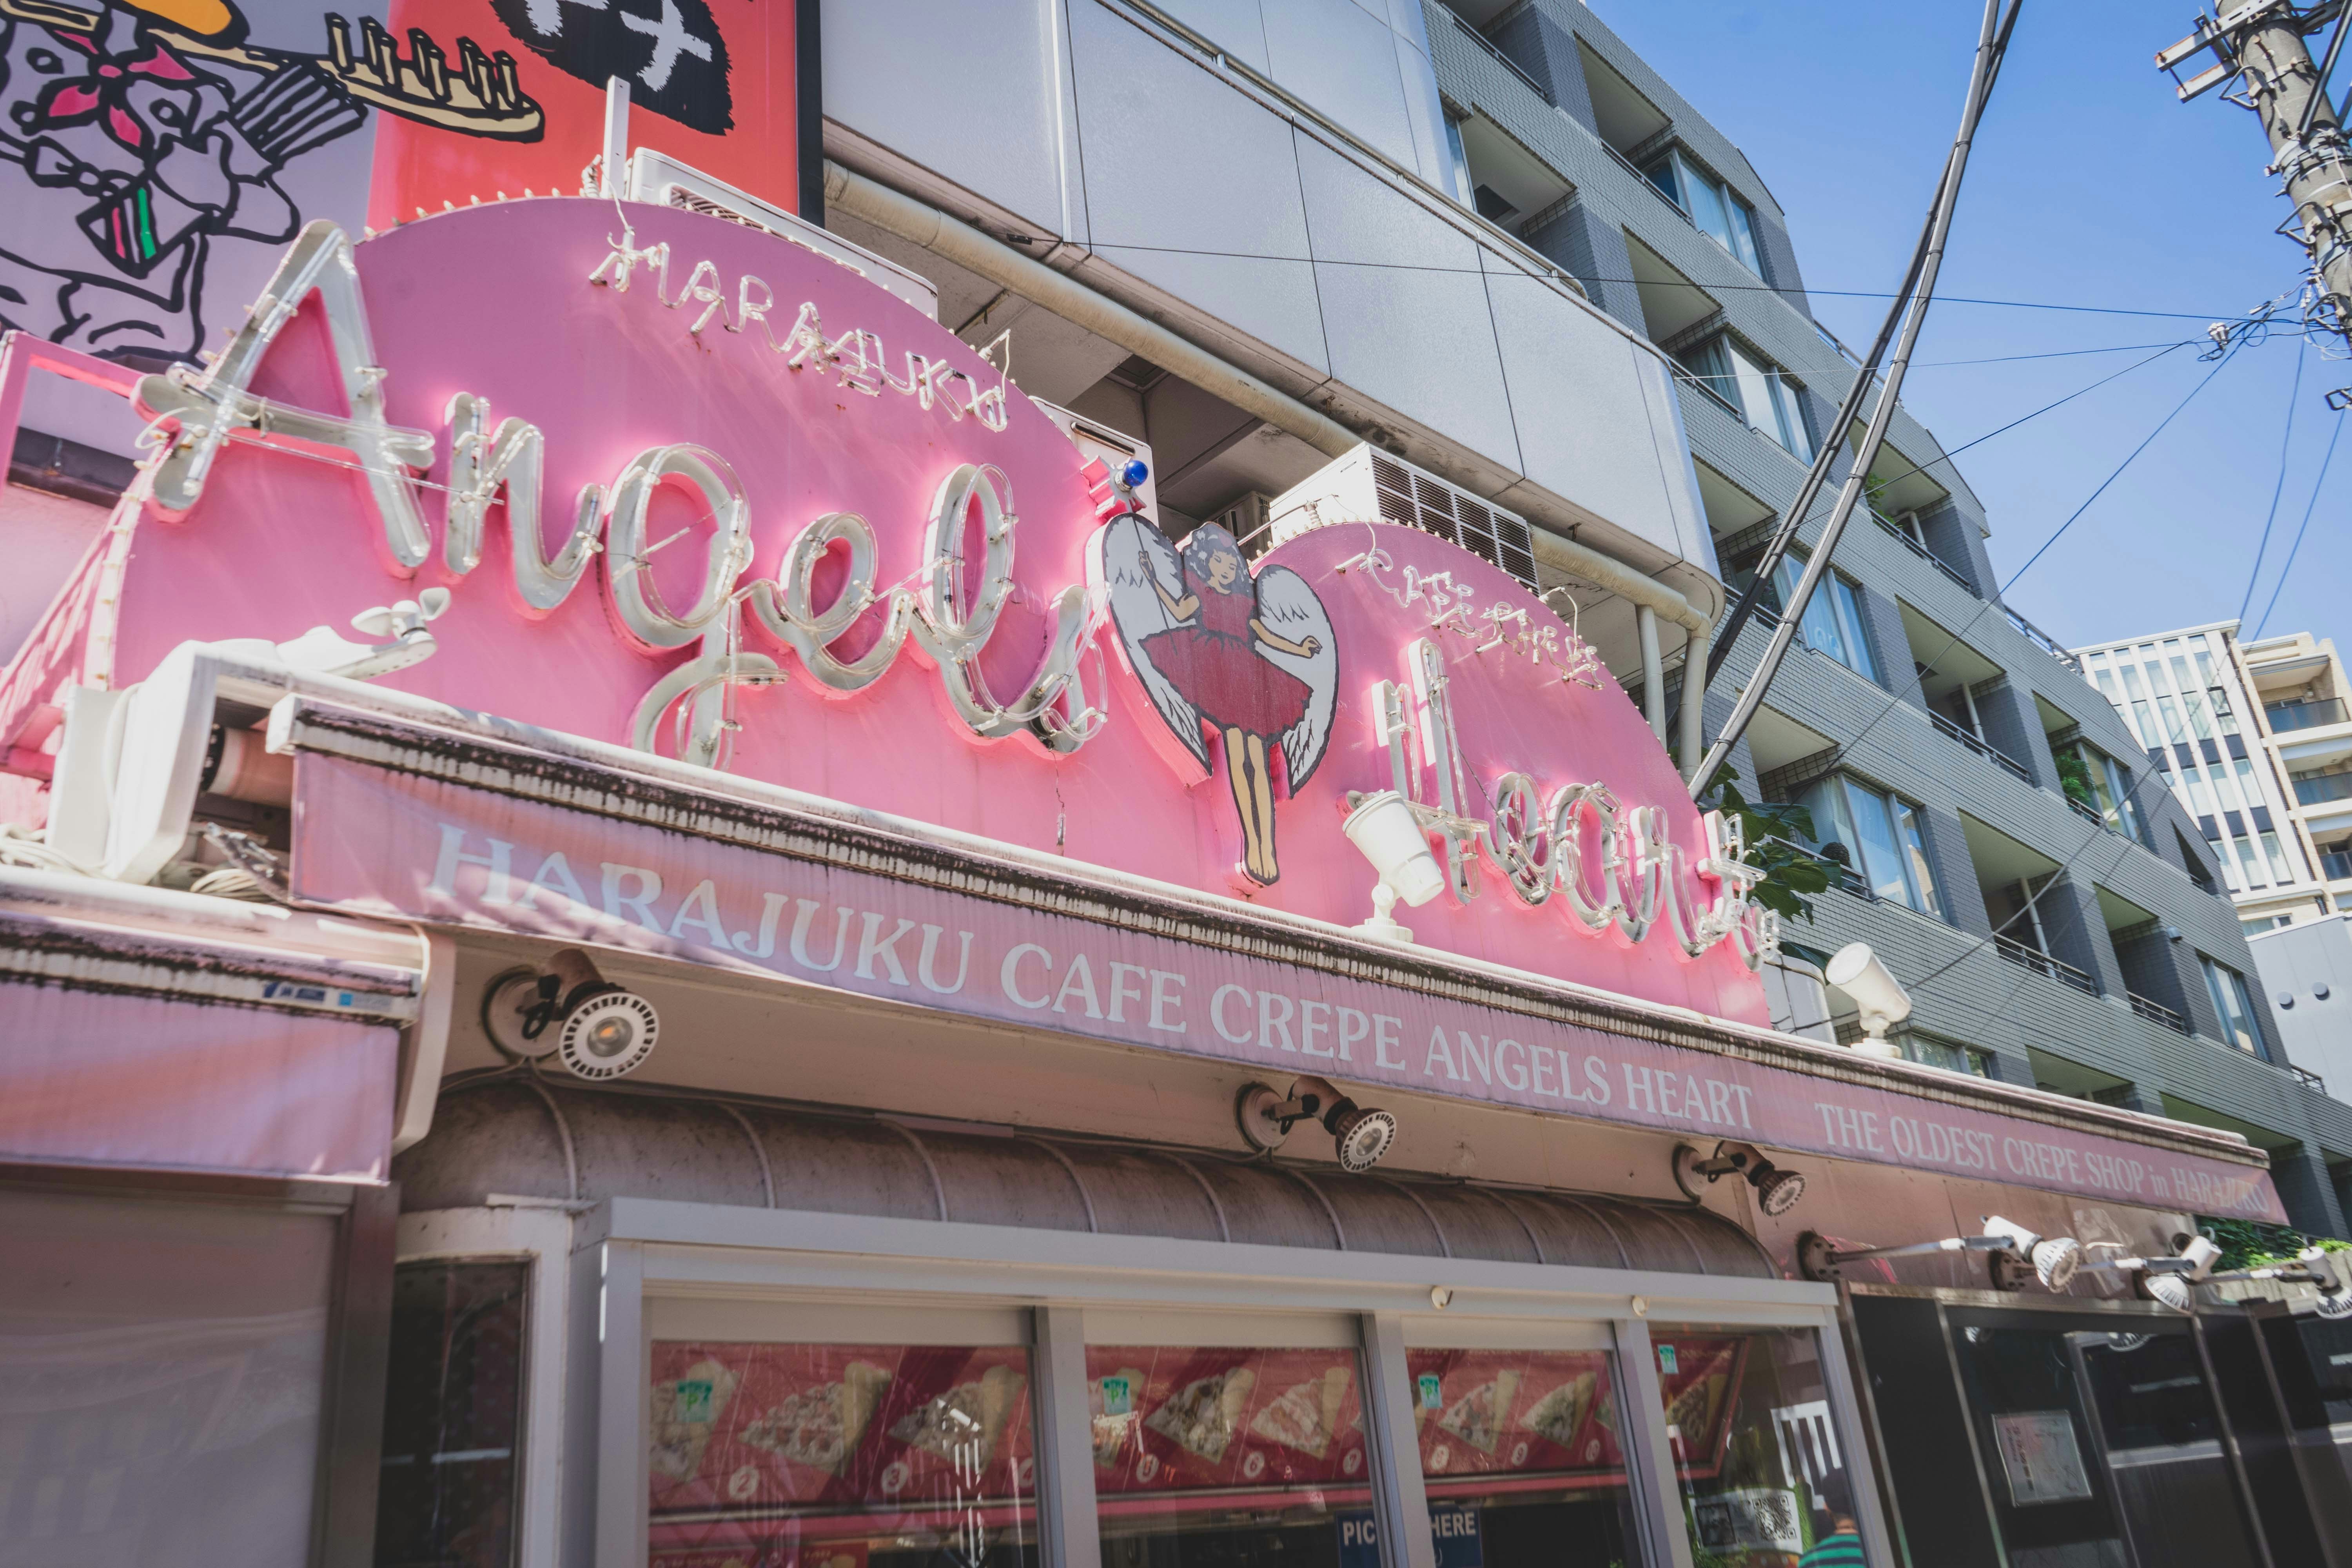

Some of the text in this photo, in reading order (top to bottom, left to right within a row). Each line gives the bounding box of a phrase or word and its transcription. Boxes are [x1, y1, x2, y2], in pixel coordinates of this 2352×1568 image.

[133, 218, 1111, 771] Angels
[426, 822, 1753, 1130] HARAJUKU CAFE CREPE ANGELS HEART
[1814, 1102, 2271, 1213] THE OLDEST CREPE SHOP in HARAJUKU
[737, 1473, 751, 1494] 2
[1343, 1520, 1376, 1547] PIC
